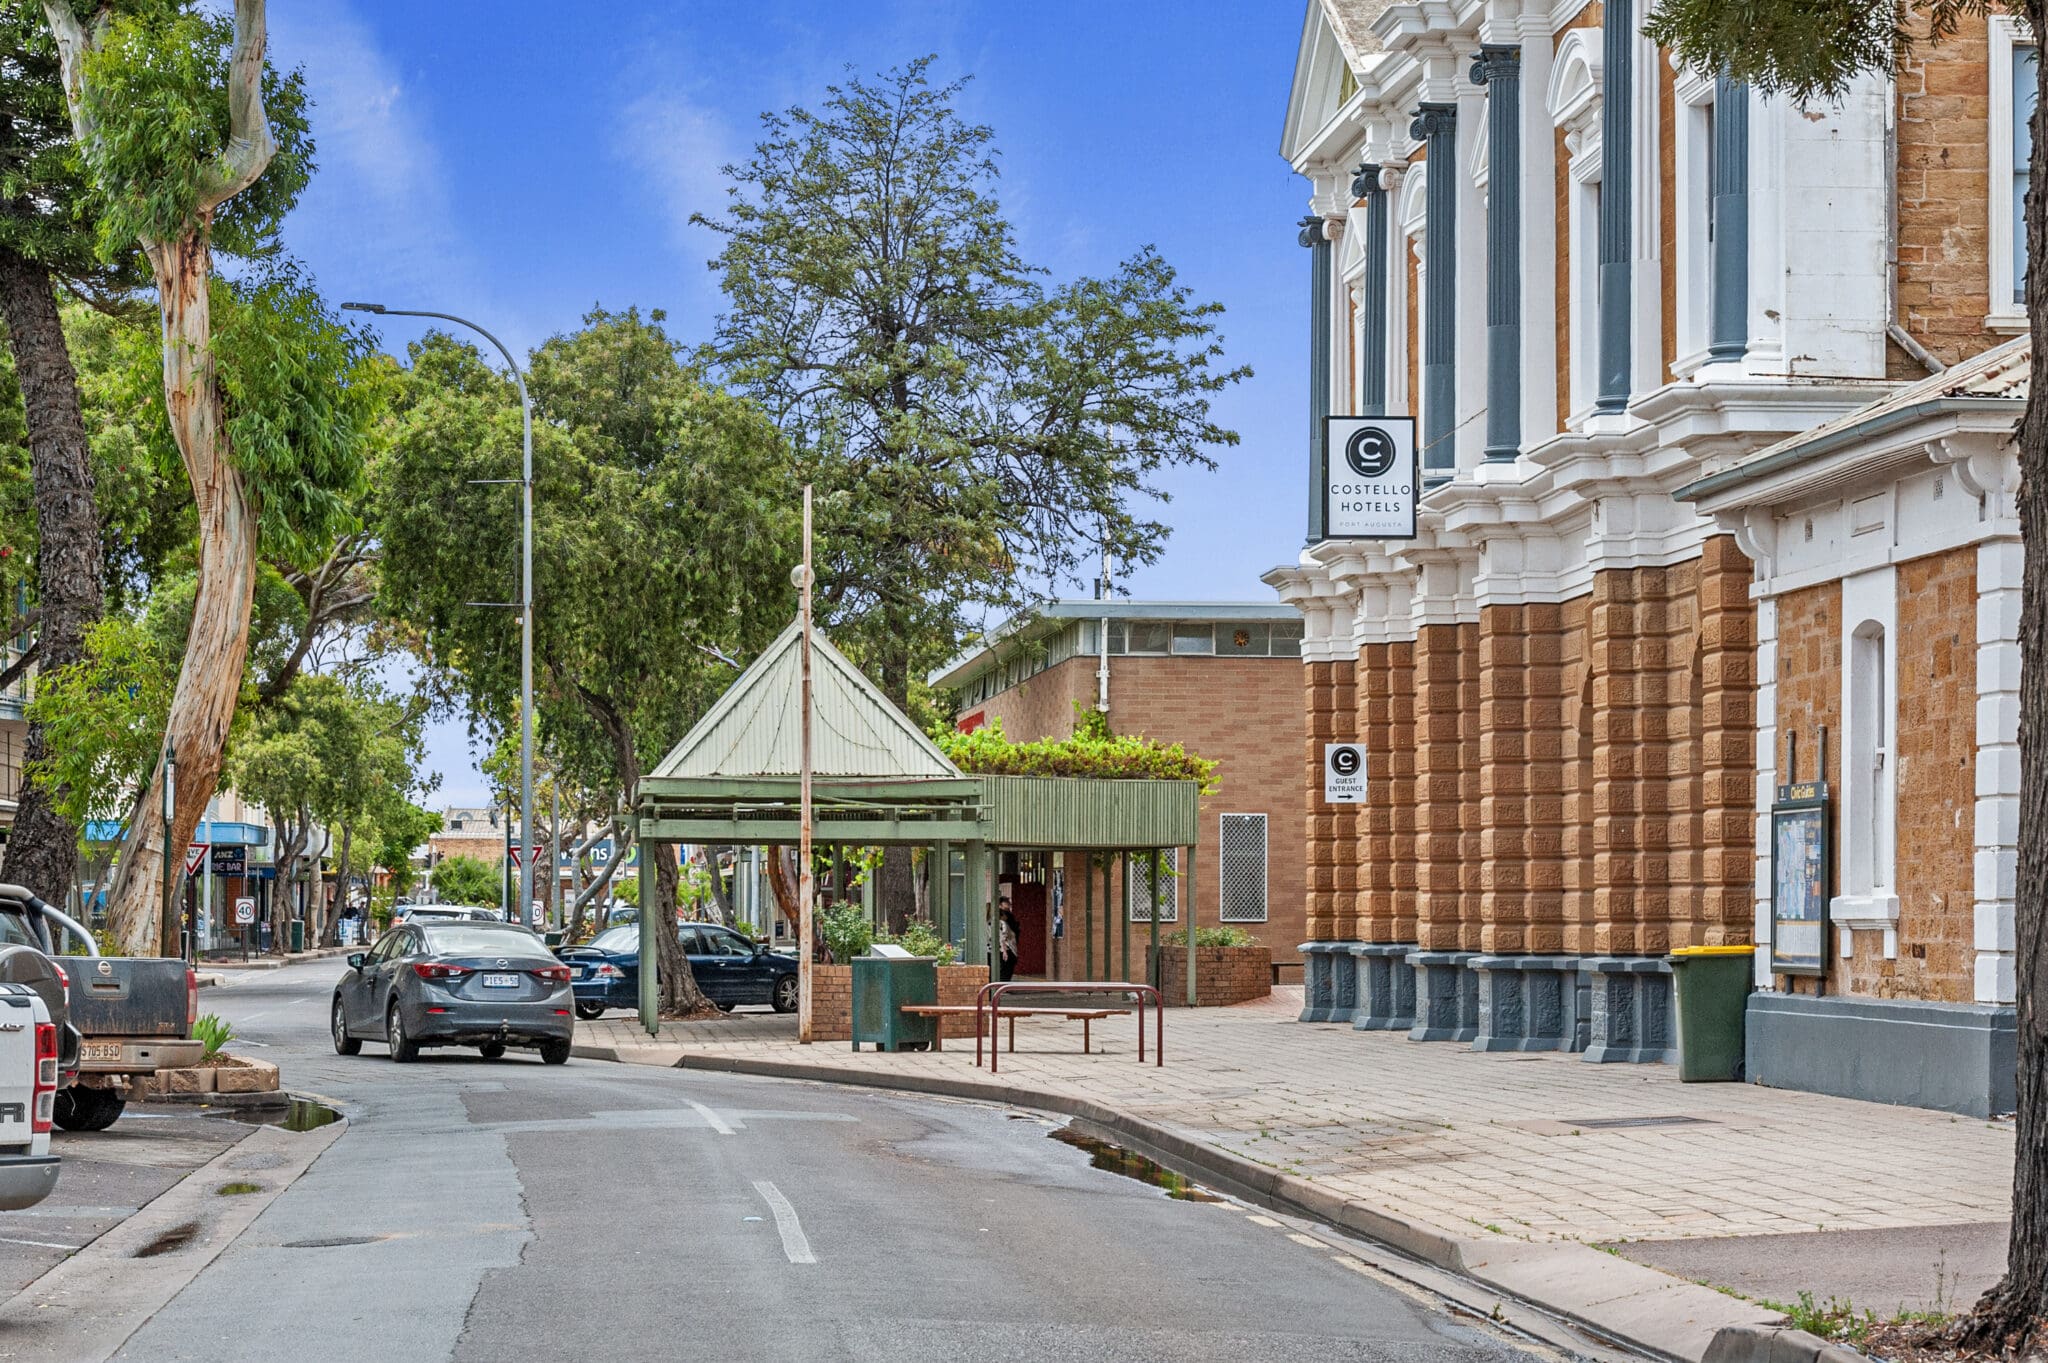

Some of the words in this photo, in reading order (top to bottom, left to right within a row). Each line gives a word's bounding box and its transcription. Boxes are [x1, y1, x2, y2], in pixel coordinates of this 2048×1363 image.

[1330, 484, 1411, 495] COSTELLO
[1341, 502, 1401, 512] HOTELS
[226, 863, 242, 871] BAR
[239, 906, 252, 916] 40
[81, 1045, 101, 1057] S705
[103, 1045, 120, 1057] BSD
